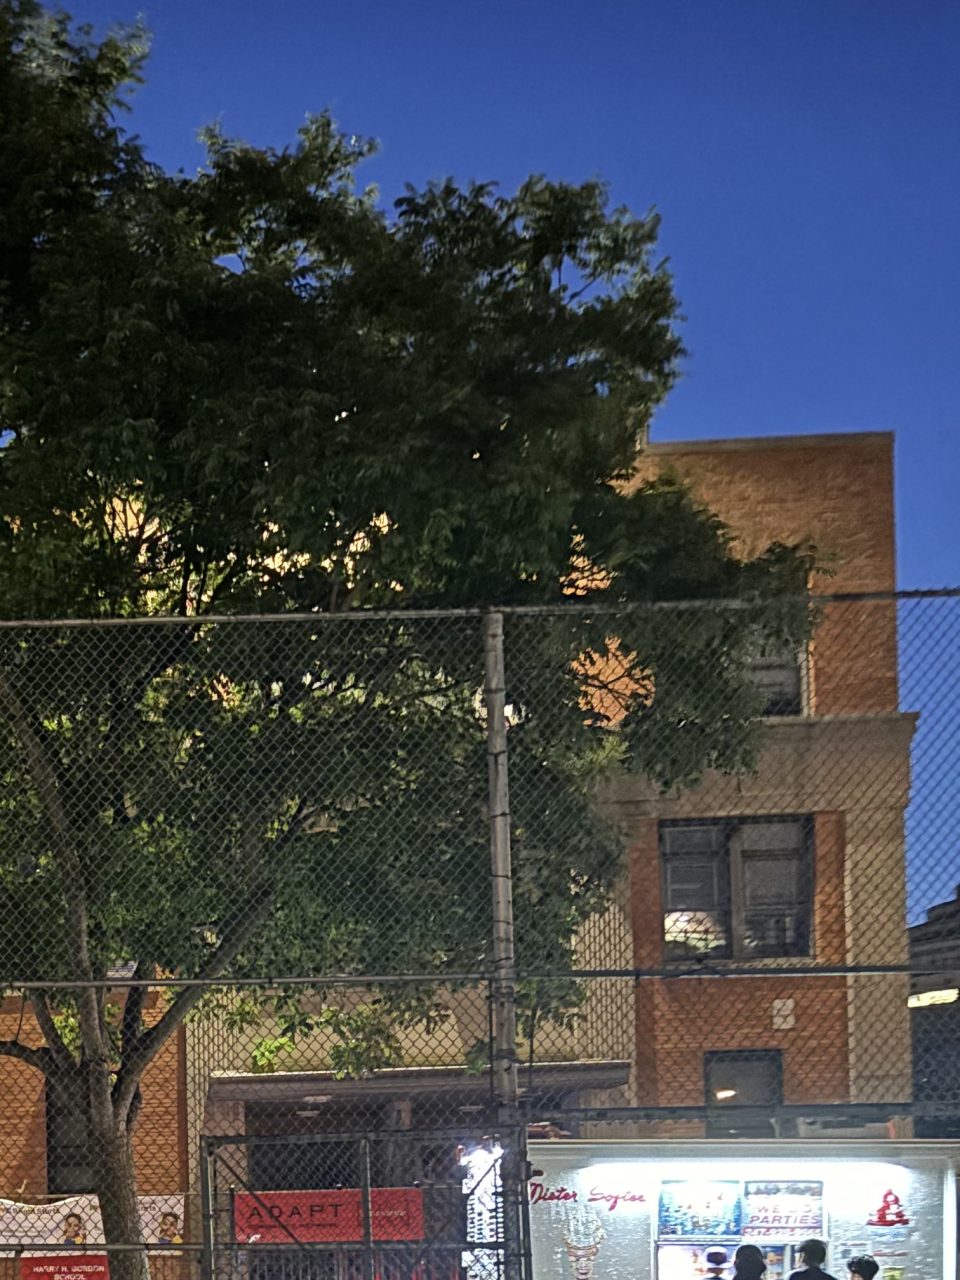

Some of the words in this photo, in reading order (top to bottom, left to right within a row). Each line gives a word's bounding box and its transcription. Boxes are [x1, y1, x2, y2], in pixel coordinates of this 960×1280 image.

[529, 1182, 578, 1205] Mister
[247, 1203, 344, 1220] ADAPT
[747, 1214, 822, 1225] PARTIES
[33, 1265, 59, 1273] HARRY
[71, 1265, 105, 1273] GORDON
[53, 1273, 87, 1280] SCHOOL
